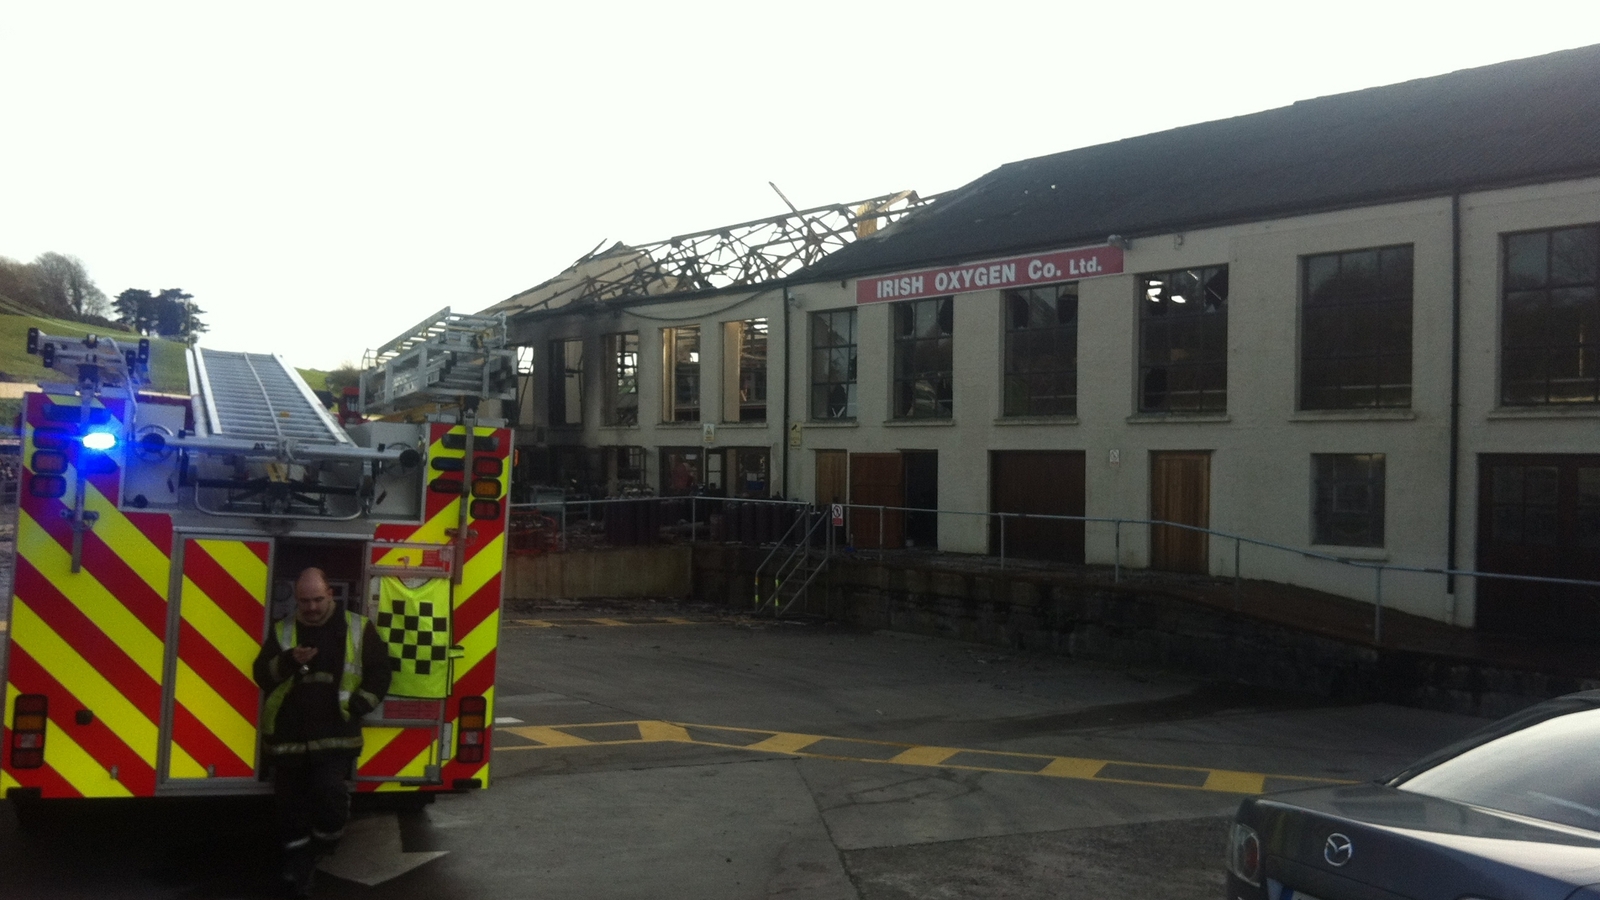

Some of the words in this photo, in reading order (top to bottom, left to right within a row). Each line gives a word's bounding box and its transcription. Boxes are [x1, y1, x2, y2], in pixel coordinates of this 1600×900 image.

[877, 276, 924, 299] IRISH
[934, 263, 1016, 291] OXYGEN
[1028, 260, 1062, 280] Co.
[1069, 256, 1102, 275] Ltd.
